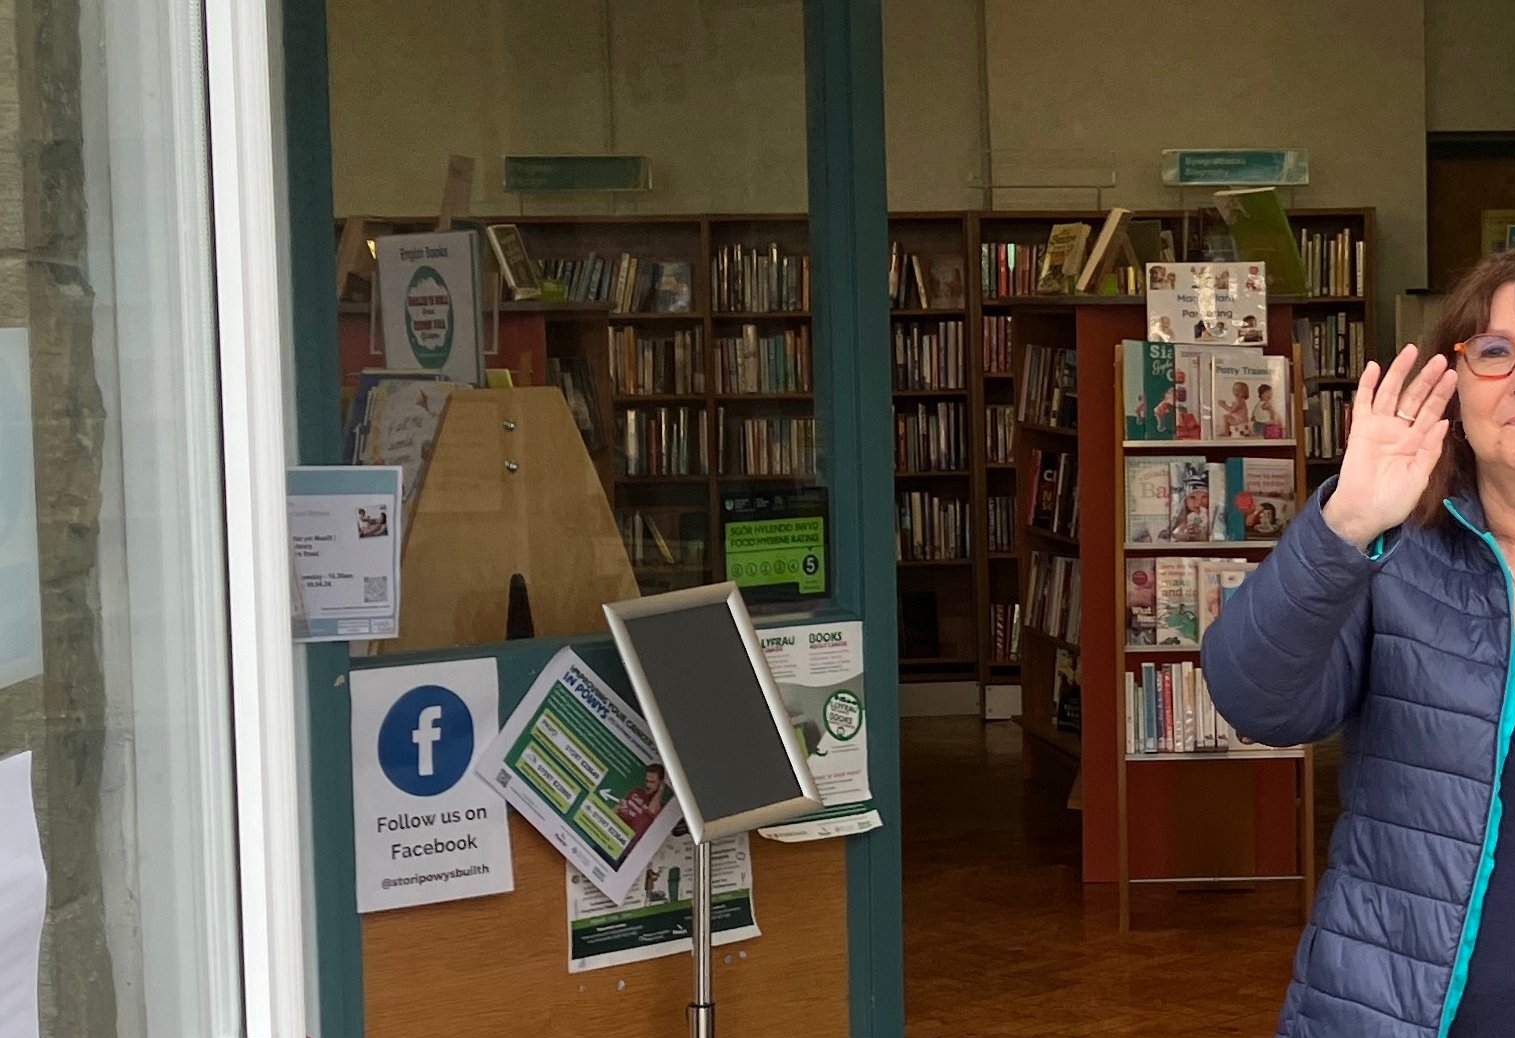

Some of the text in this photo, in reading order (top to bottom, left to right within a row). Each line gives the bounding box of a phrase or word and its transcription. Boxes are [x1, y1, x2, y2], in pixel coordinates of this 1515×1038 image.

[731, 538, 755, 548] FOOD
[792, 533, 820, 544] RATING
[806, 557, 816, 573] 5
[809, 631, 843, 644] BOOKS
[563, 671, 610, 720] IN POWYS
[411, 704, 443, 777] f
[377, 807, 488, 833] Follow us on
[391, 833, 478, 860] Facebook
[381, 863, 490, 890] @storipowysbuilth
